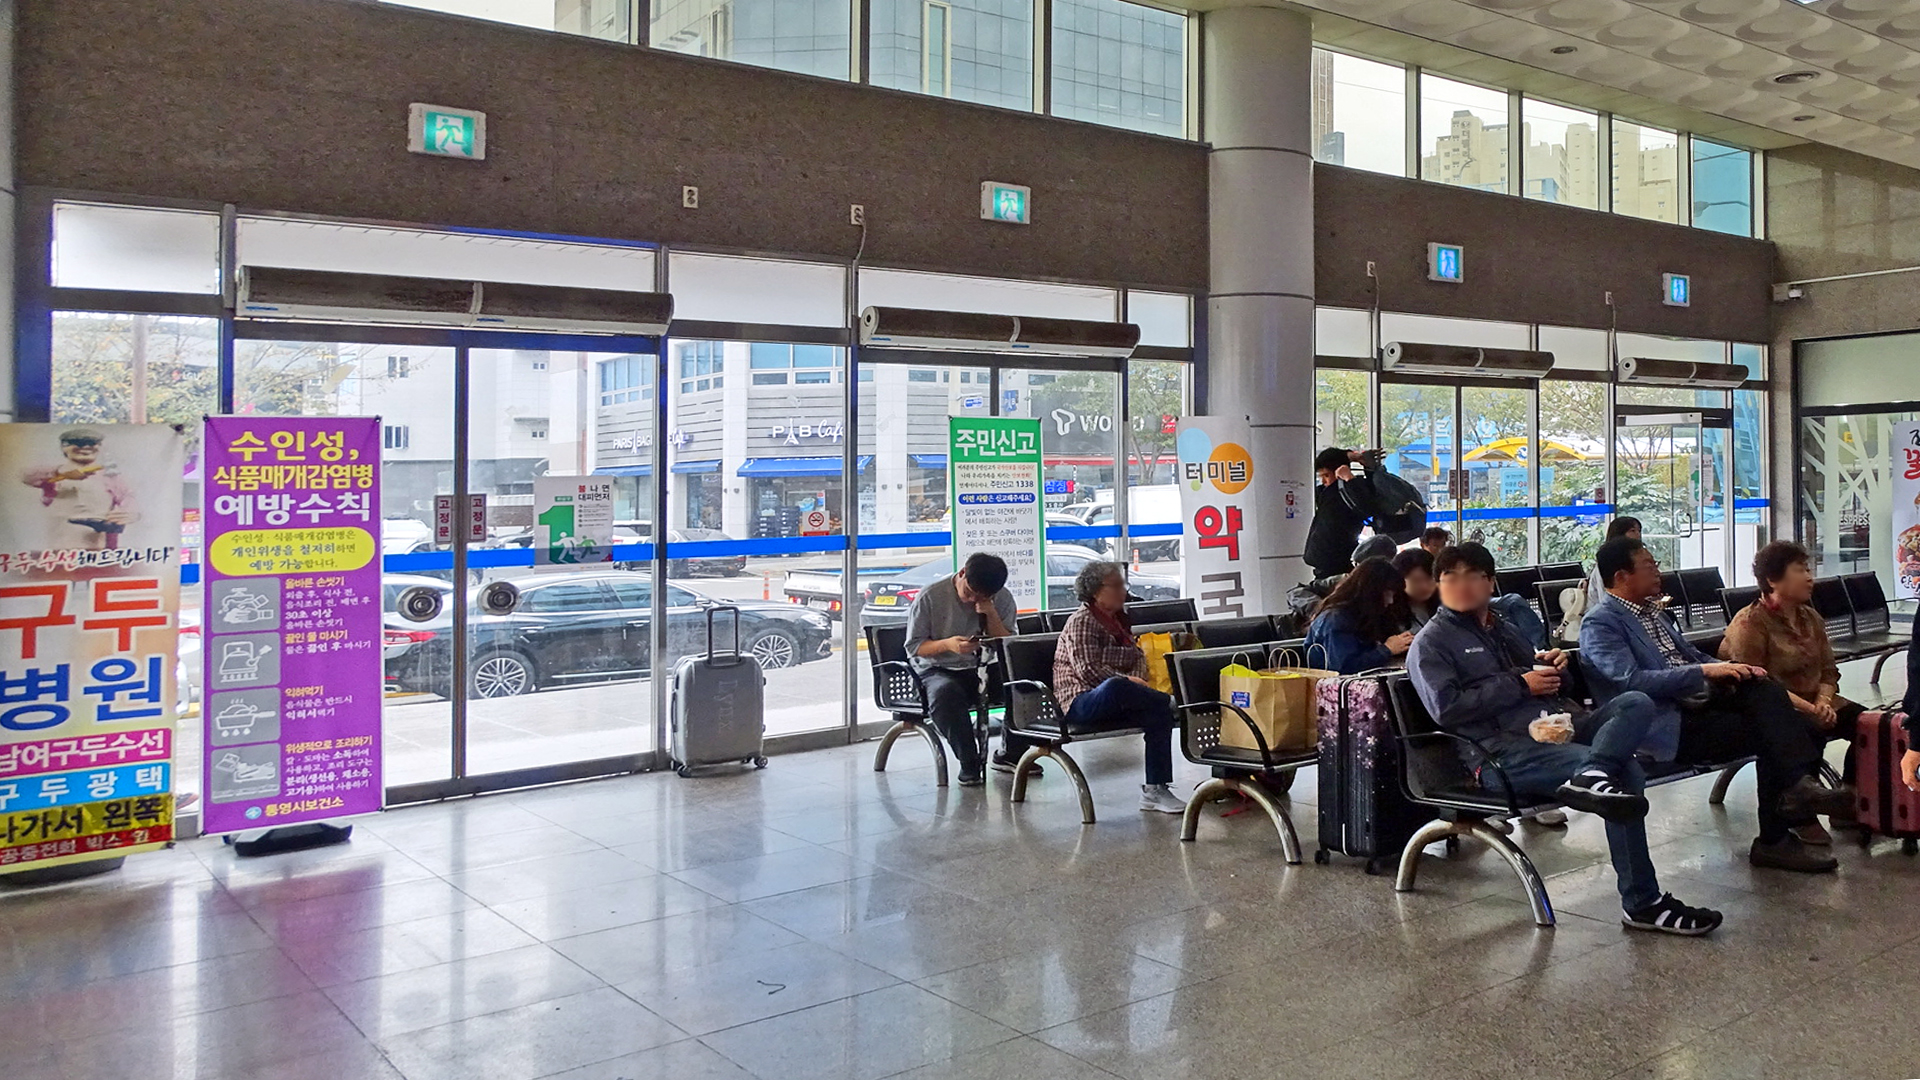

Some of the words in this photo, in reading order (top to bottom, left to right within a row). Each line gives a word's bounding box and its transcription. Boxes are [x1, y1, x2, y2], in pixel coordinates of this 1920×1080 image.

[228, 431, 360, 462] 수인성,
[955, 429, 1037, 457] 주민신고
[213, 464, 374, 491] 식품매개감염병
[1186, 461, 1246, 483] 터미널
[990, 480, 1014, 488] 주민신고
[1016, 480, 1034, 488] 1338
[214, 492, 370, 526] 예방수칙
[231, 533, 263, 544] 수인성
[231, 545, 293, 558] 개인위생을
[300, 543, 356, 555] 철저히하면
[249, 559, 275, 571] 예방
[279, 558, 338, 570] 가능합니다.
[285, 577, 314, 589] 올바른
[316, 576, 345, 588] 손씻기
[323, 588, 341, 597] 식사
[286, 598, 322, 610] 음식조리
[0, 579, 168, 660] 구두
[285, 610, 309, 620] 30초
[311, 608, 333, 618] 이상
[316, 618, 344, 628] 손씻기
[285, 632, 304, 644] 끓인
[306, 631, 317, 642] 물
[319, 629, 348, 641] 마시기
[306, 642, 328, 653] 끓인
[331, 641, 342, 651] 후
[344, 640, 371, 649] 마시기
[0, 656, 163, 731] 병원
[285, 685, 324, 697] 익혀먹기
[285, 698, 323, 709] 음식물은
[325, 695, 353, 706] 반드시
[0, 731, 164, 772] 남여구두수선
[285, 739, 333, 754] 위생적으로
[335, 735, 373, 748] 조리하기
[333, 748, 370, 759] 소독하여
[347, 758, 373, 767] 도구는
[102, 797, 162, 829] 왼쪽
[265, 796, 345, 817] 통영시보건소
[86, 832, 124, 850] 박스
